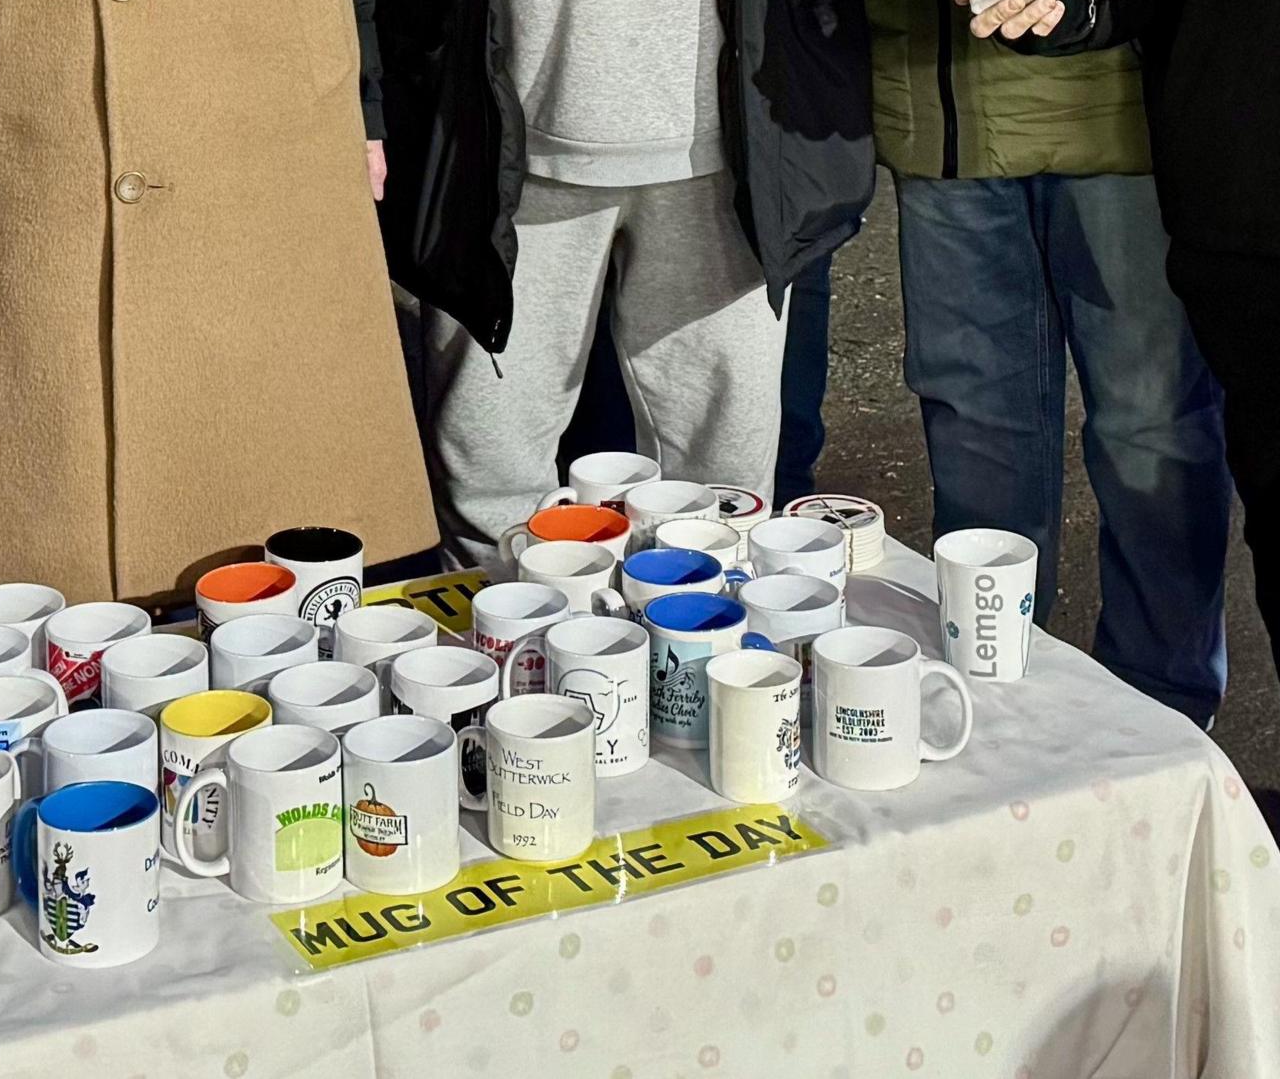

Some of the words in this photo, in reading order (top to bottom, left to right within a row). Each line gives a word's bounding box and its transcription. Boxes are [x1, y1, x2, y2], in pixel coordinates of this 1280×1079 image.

[968, 574, 1004, 678] Lemgo
[671, 702, 698, 718] Choir
[835, 706, 885, 719] LINCOLNSHIRE
[859, 727, 878, 737] 2003
[276, 802, 330, 827] WOLDS
[374, 817, 403, 835] FARM
[512, 834, 537, 847] 1992
[289, 903, 432, 955] MUG
[445, 874, 525, 917] OF
[546, 843, 683, 893] THE
[687, 815, 804, 860] DAY
